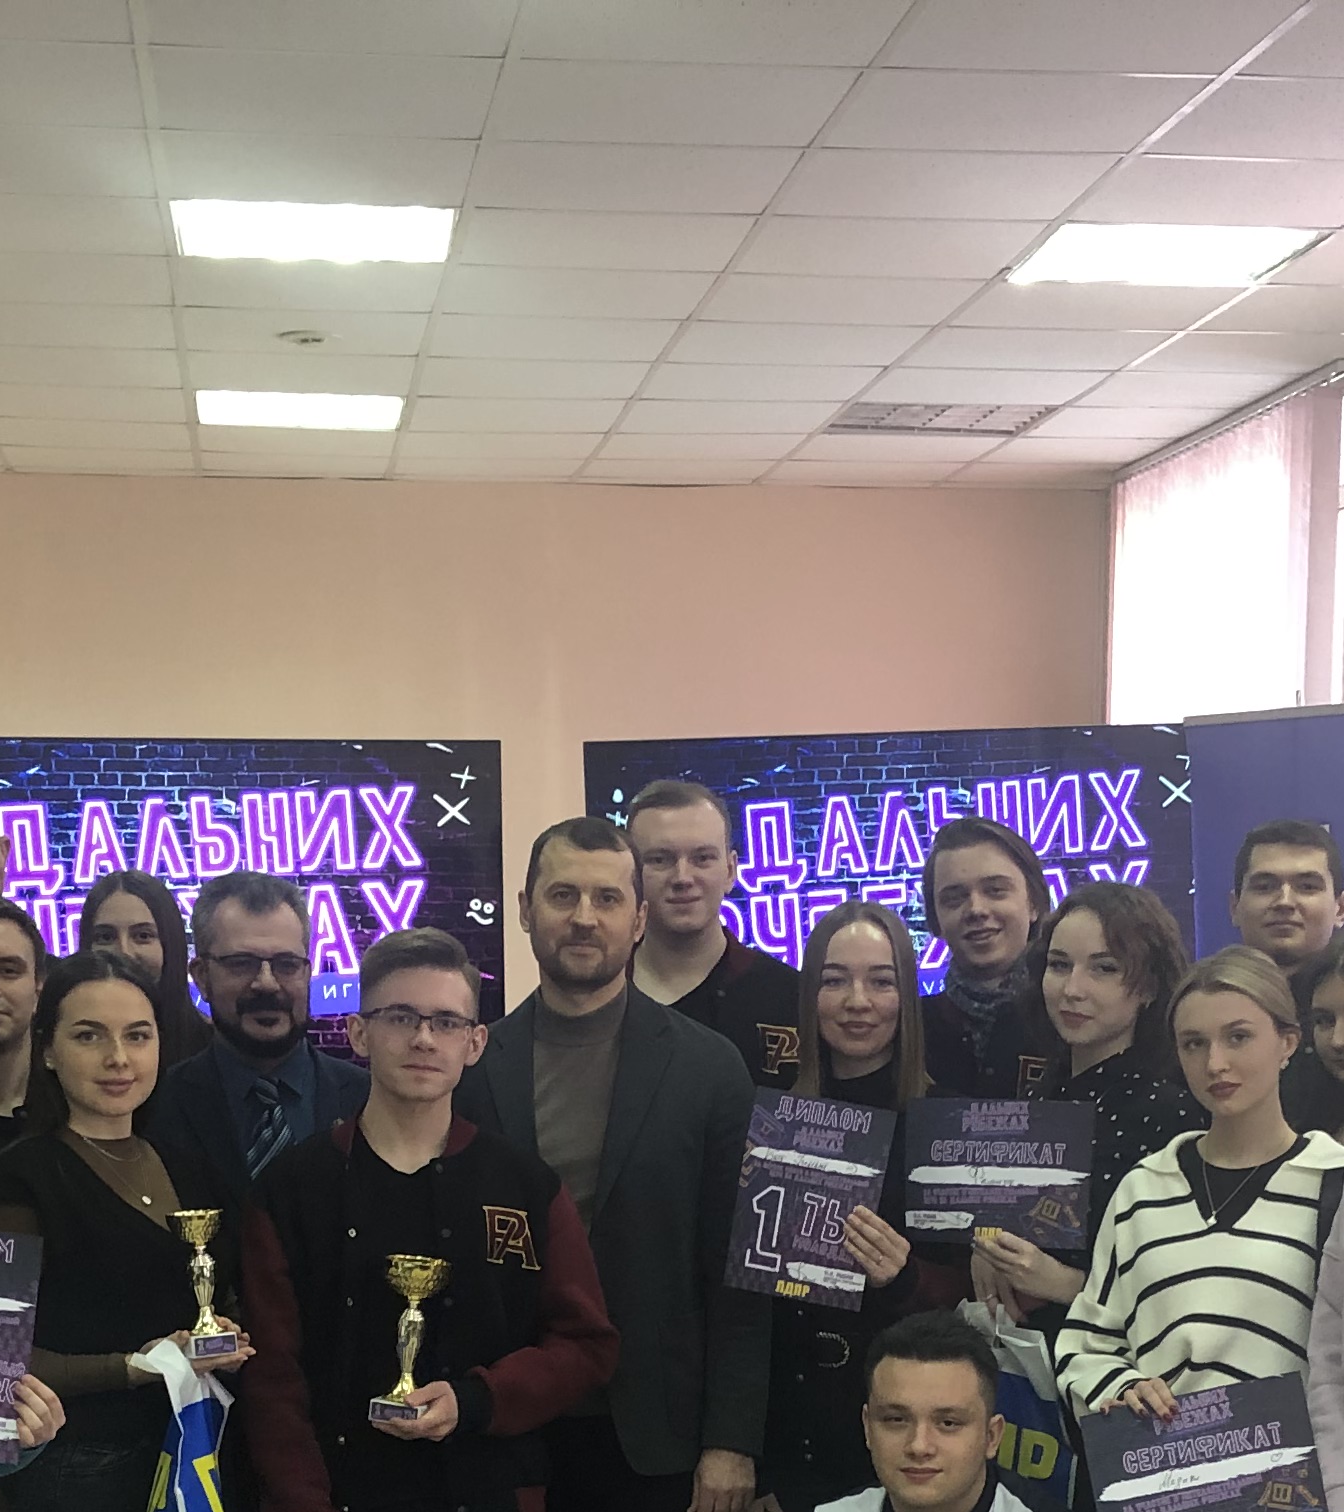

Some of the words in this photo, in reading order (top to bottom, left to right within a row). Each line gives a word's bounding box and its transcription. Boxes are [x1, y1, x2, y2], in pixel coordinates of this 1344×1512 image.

[775, 1096, 872, 1134] ДИПЛОМ
[930, 1139, 1067, 1165] СЕРТИФИКАТ
[775, 1279, 810, 1298] ЛДПР
[1122, 1421, 1282, 1474] СЕРТИФИКАТ
